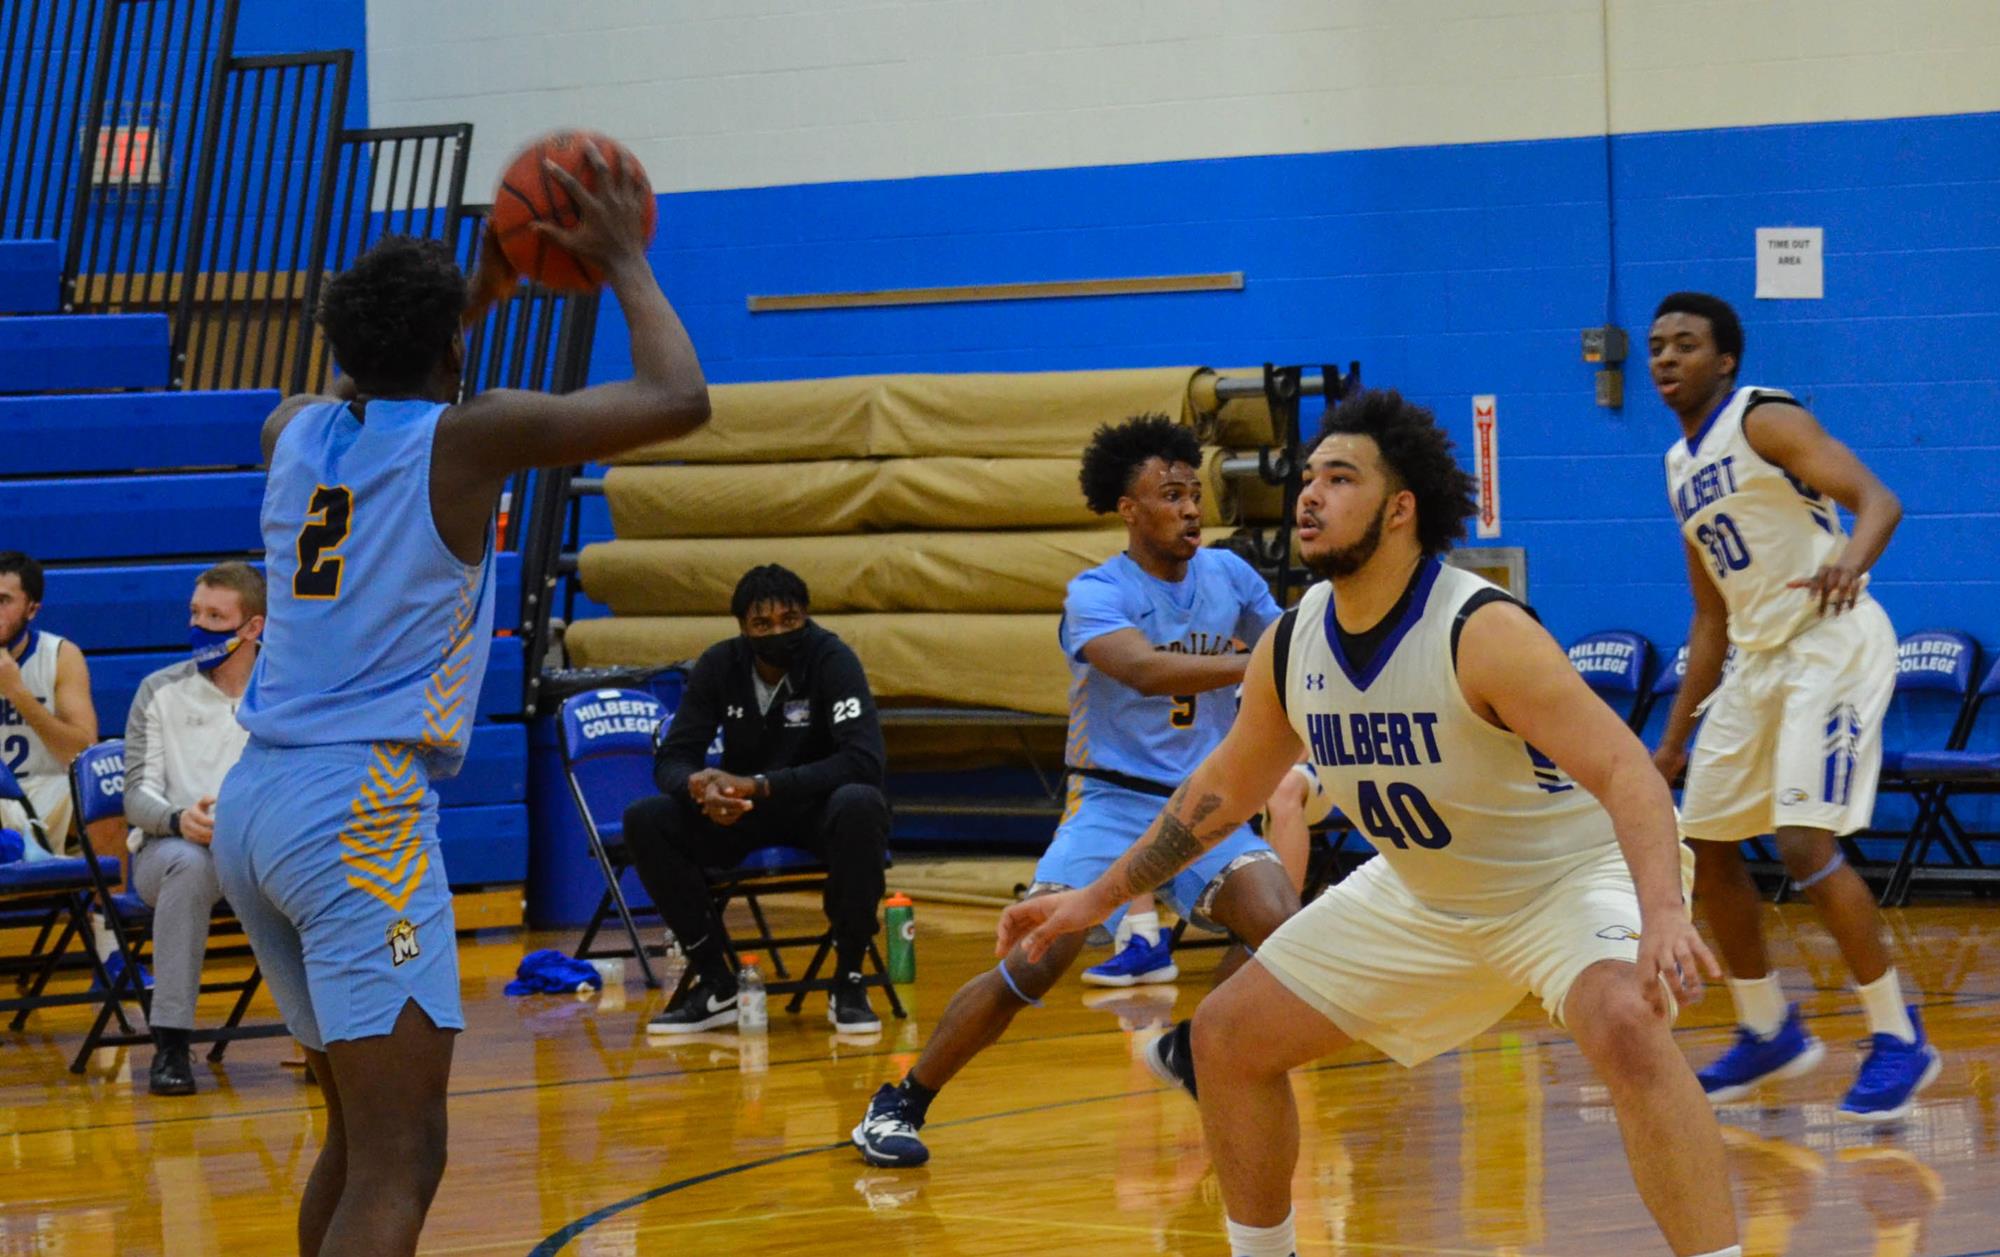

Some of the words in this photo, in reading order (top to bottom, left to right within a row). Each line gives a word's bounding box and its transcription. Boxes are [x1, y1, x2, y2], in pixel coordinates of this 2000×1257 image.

[1768, 239, 1789, 249] TIME
[1791, 239, 1810, 249] OUT
[1778, 255, 1802, 266] AREA
[293, 483, 353, 600] 2
[1697, 513, 1751, 579] 30
[1568, 641, 1635, 660] HILBERT
[1571, 657, 1629, 675] OLLEGE
[574, 700, 659, 722] HILBERT
[832, 697, 861, 724] 23
[1306, 712, 1442, 766] HILBERT
[1357, 780, 1452, 850] 40
[391, 929, 420, 967] M
